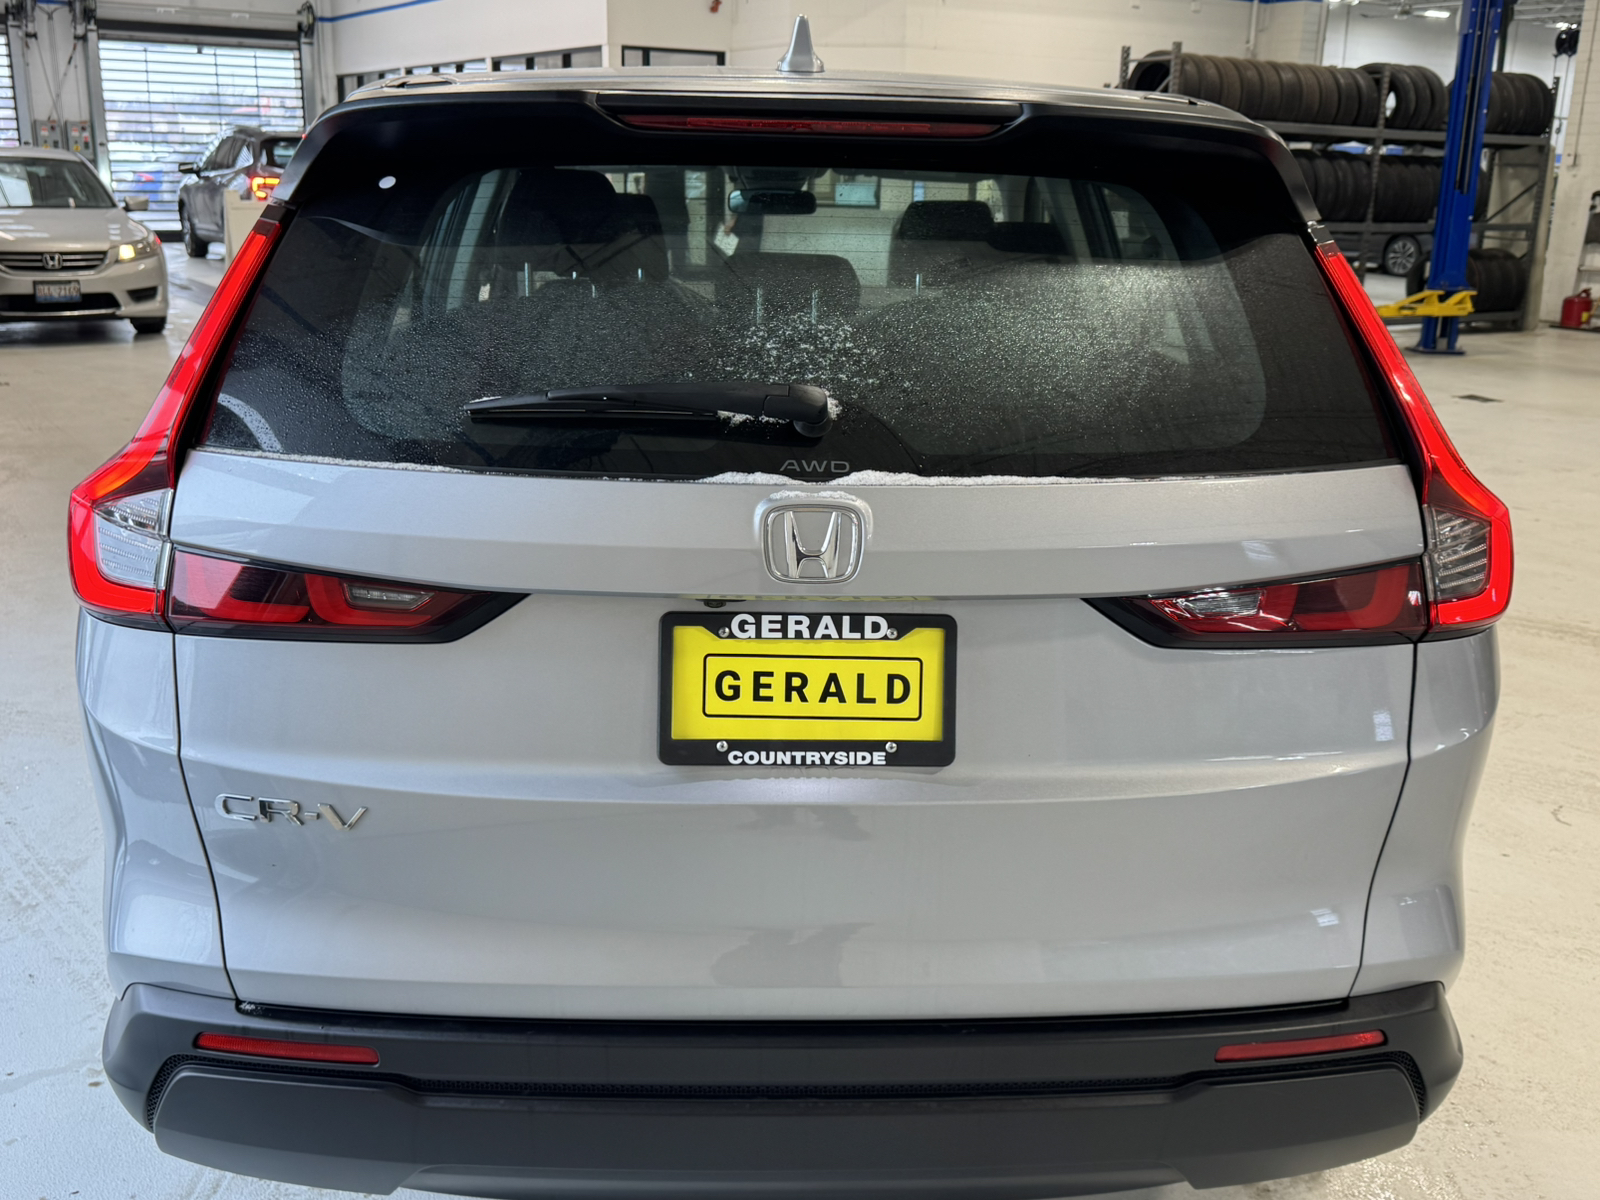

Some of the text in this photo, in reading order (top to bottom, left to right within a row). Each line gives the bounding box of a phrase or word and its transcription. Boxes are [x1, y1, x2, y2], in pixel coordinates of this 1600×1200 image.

[780, 460, 850, 473] AWD
[730, 613, 889, 639] GERALD
[714, 670, 911, 704] GERALD
[727, 750, 886, 765] COUNTRYSIDE
[214, 793, 368, 831] CR-V
